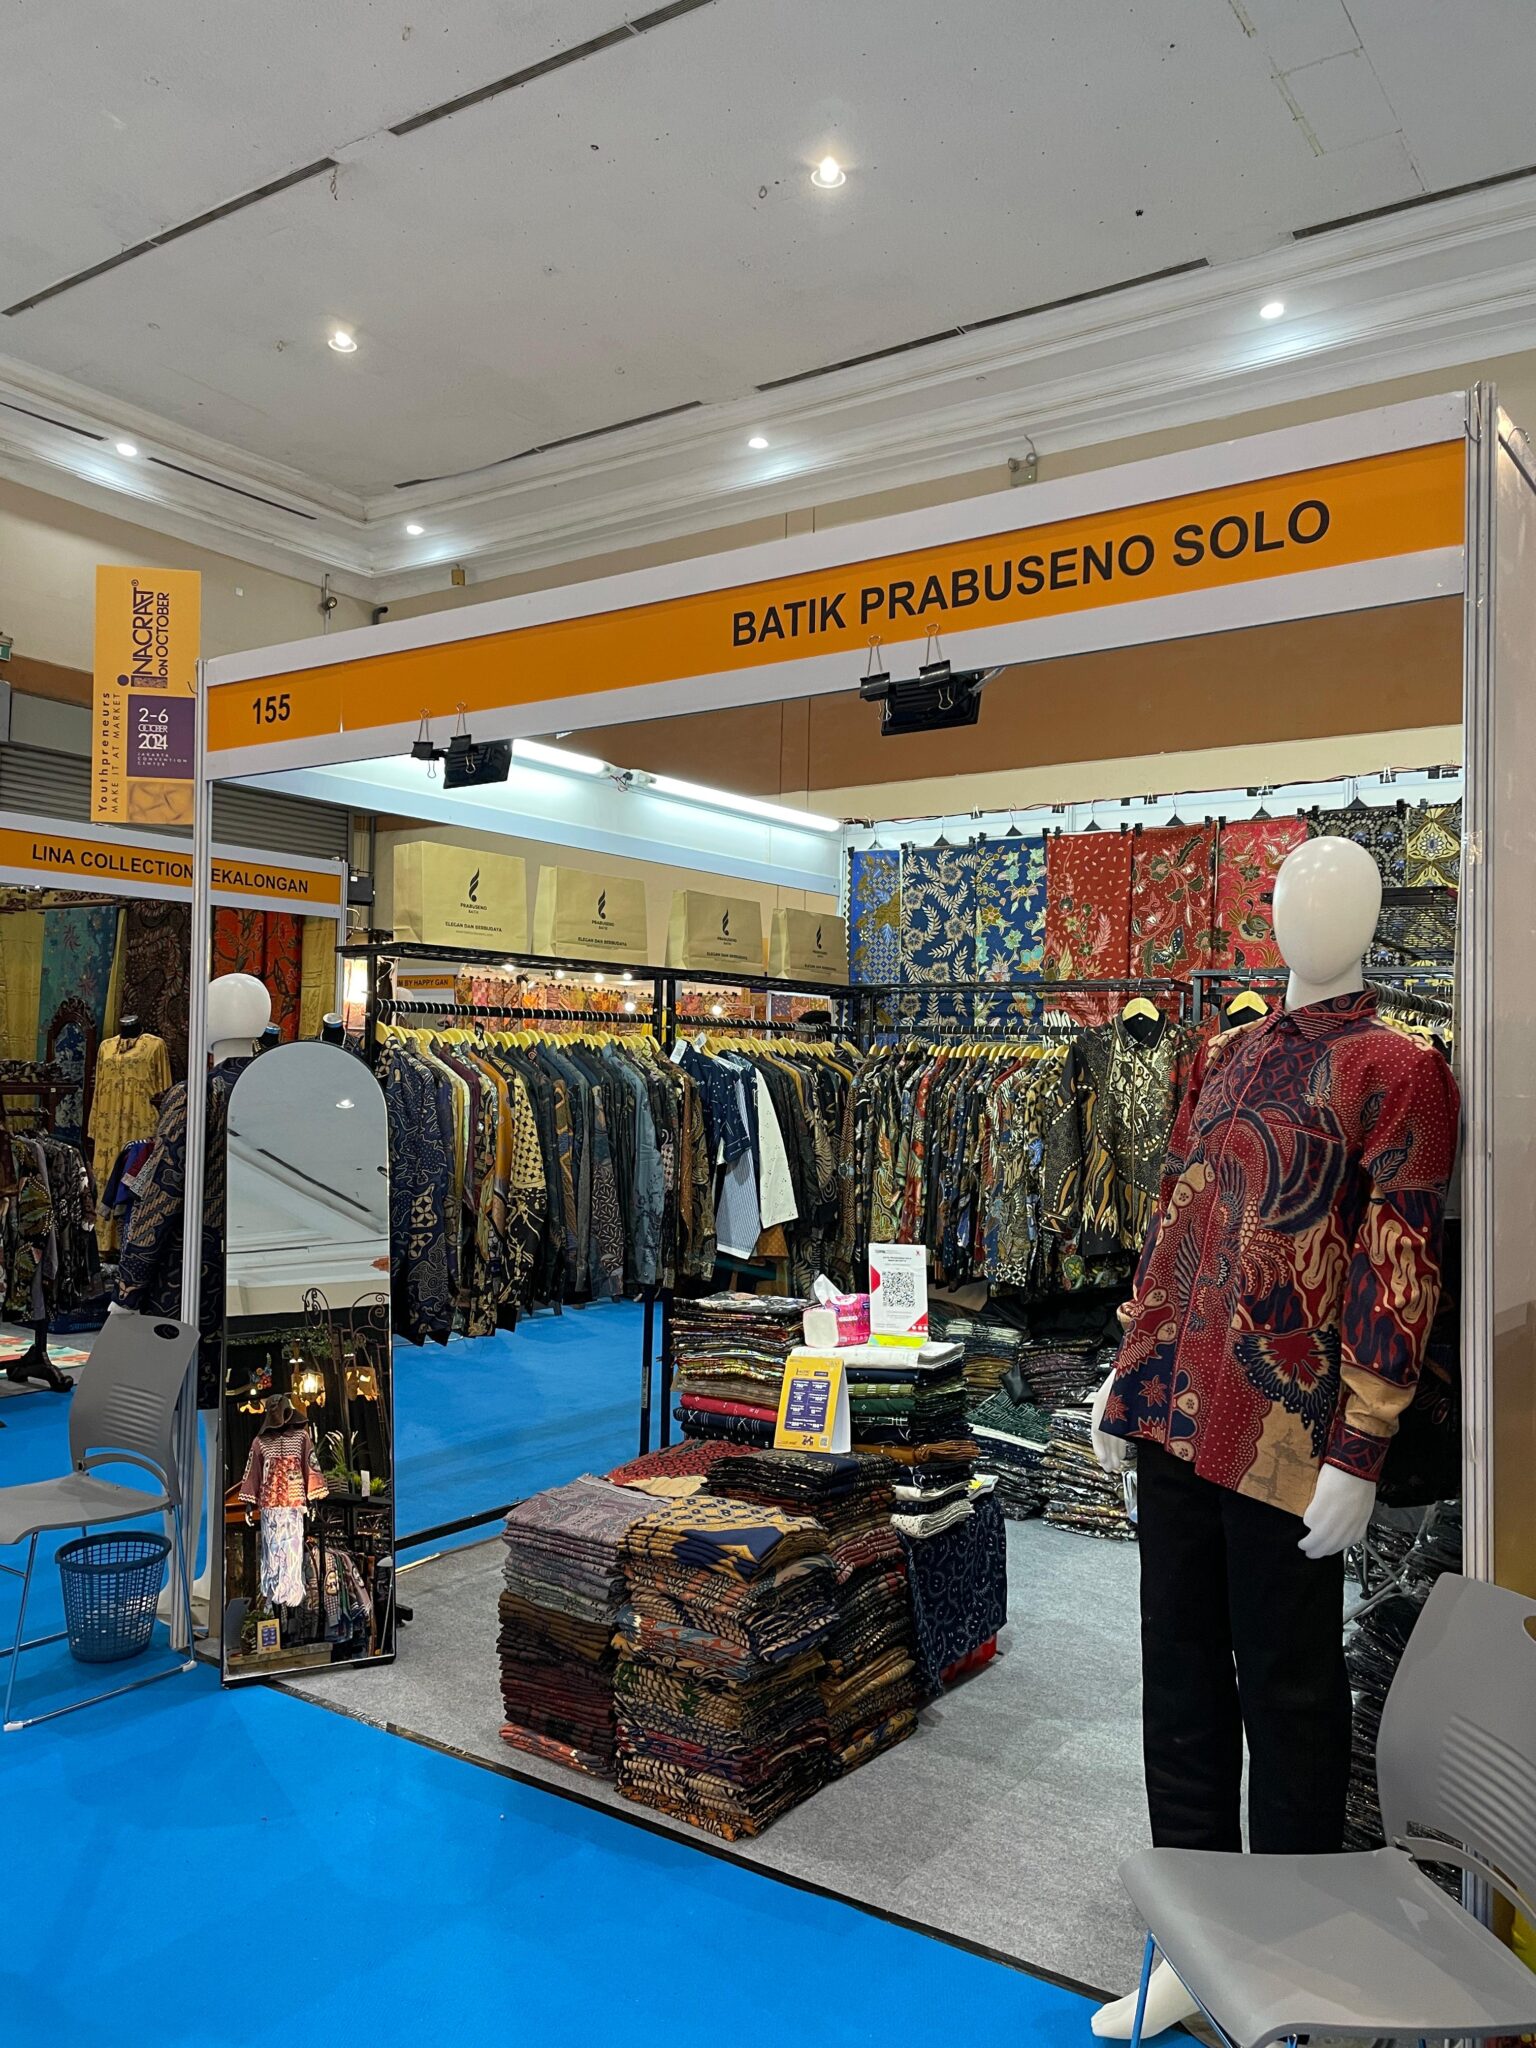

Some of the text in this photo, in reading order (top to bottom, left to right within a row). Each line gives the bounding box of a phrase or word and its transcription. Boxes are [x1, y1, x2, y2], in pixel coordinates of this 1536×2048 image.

[732, 499, 1331, 647] BATIK PRABUSENO SOLO
[156, 592, 169, 676] ON OCTOBER
[138, 707, 169, 723] 2-6
[138, 733, 168, 750] 2024
[252, 693, 291, 724] 155
[98, 692, 110, 812] Youthpreneurs
[111, 693, 121, 813] MAKE IT AT MARKET
[32, 844, 308, 894] LINA COLLECTION EKALONGAN
